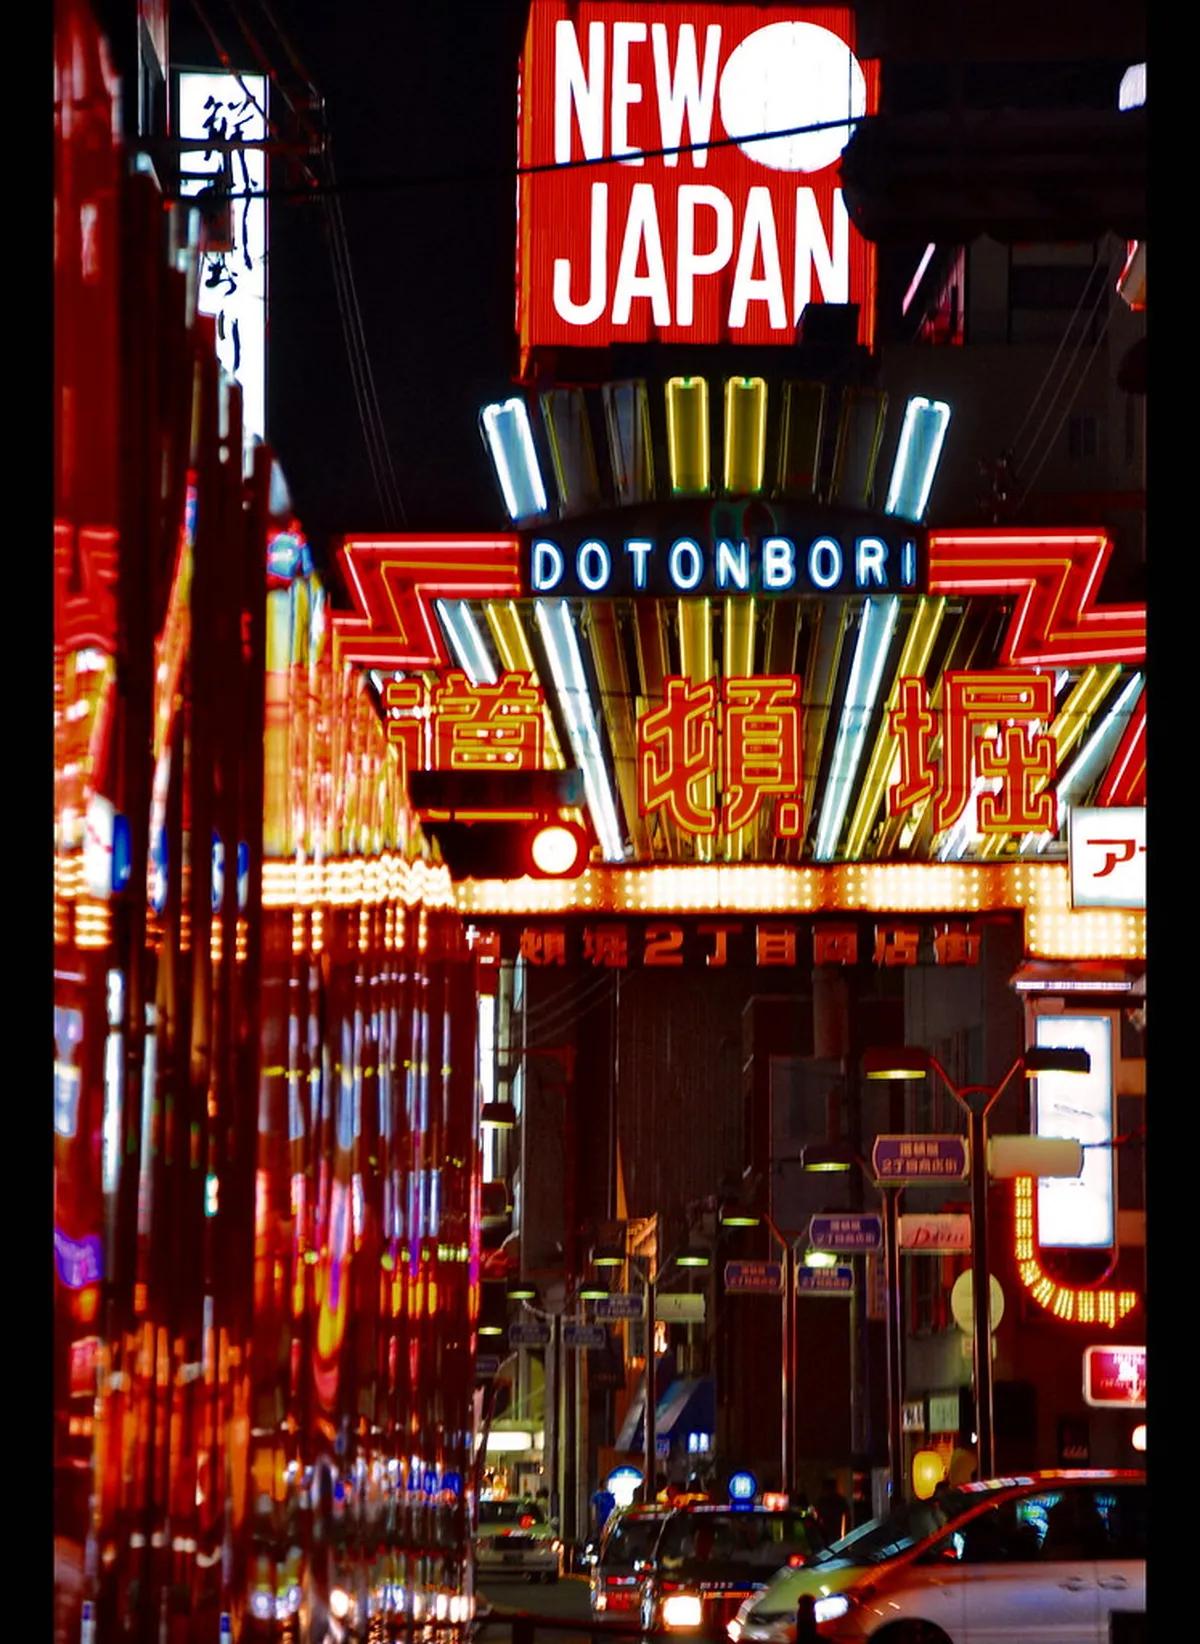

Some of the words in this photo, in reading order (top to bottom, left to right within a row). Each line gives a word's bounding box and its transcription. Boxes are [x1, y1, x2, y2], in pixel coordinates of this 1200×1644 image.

[554, 20, 722, 168] NEW
[553, 183, 850, 329] JAPAN
[532, 538, 916, 591] DOTONBORI
[382, 668, 1057, 838] 道頓堀
[1087, 839, 1146, 877] ア
